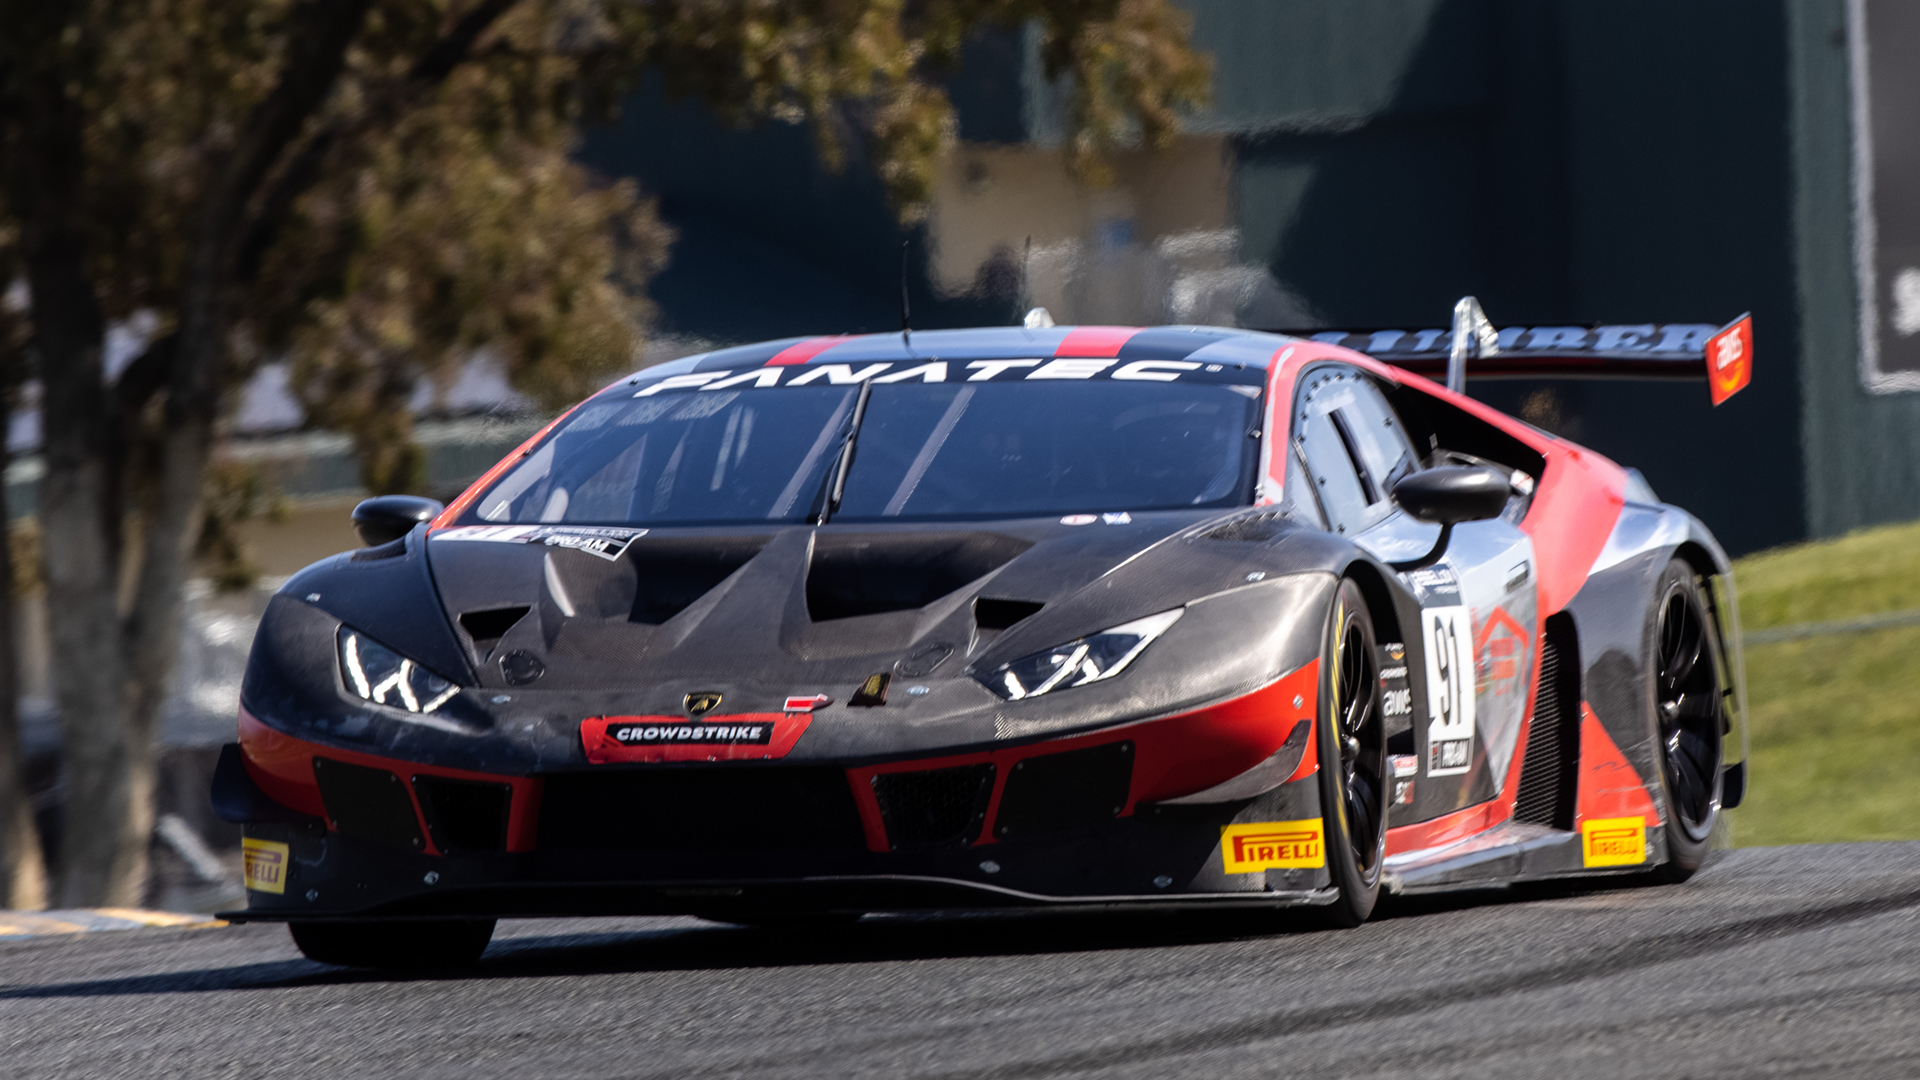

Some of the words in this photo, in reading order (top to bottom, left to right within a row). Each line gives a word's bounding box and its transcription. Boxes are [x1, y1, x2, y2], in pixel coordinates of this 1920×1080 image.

[632, 358, 1203, 398] FANATEC
[616, 726, 762, 741] CROWDSTRIKE
[1232, 831, 1319, 863] PIRELLI
[1590, 828, 1638, 857] PIRELLI
[243, 847, 282, 884] PRELLI
